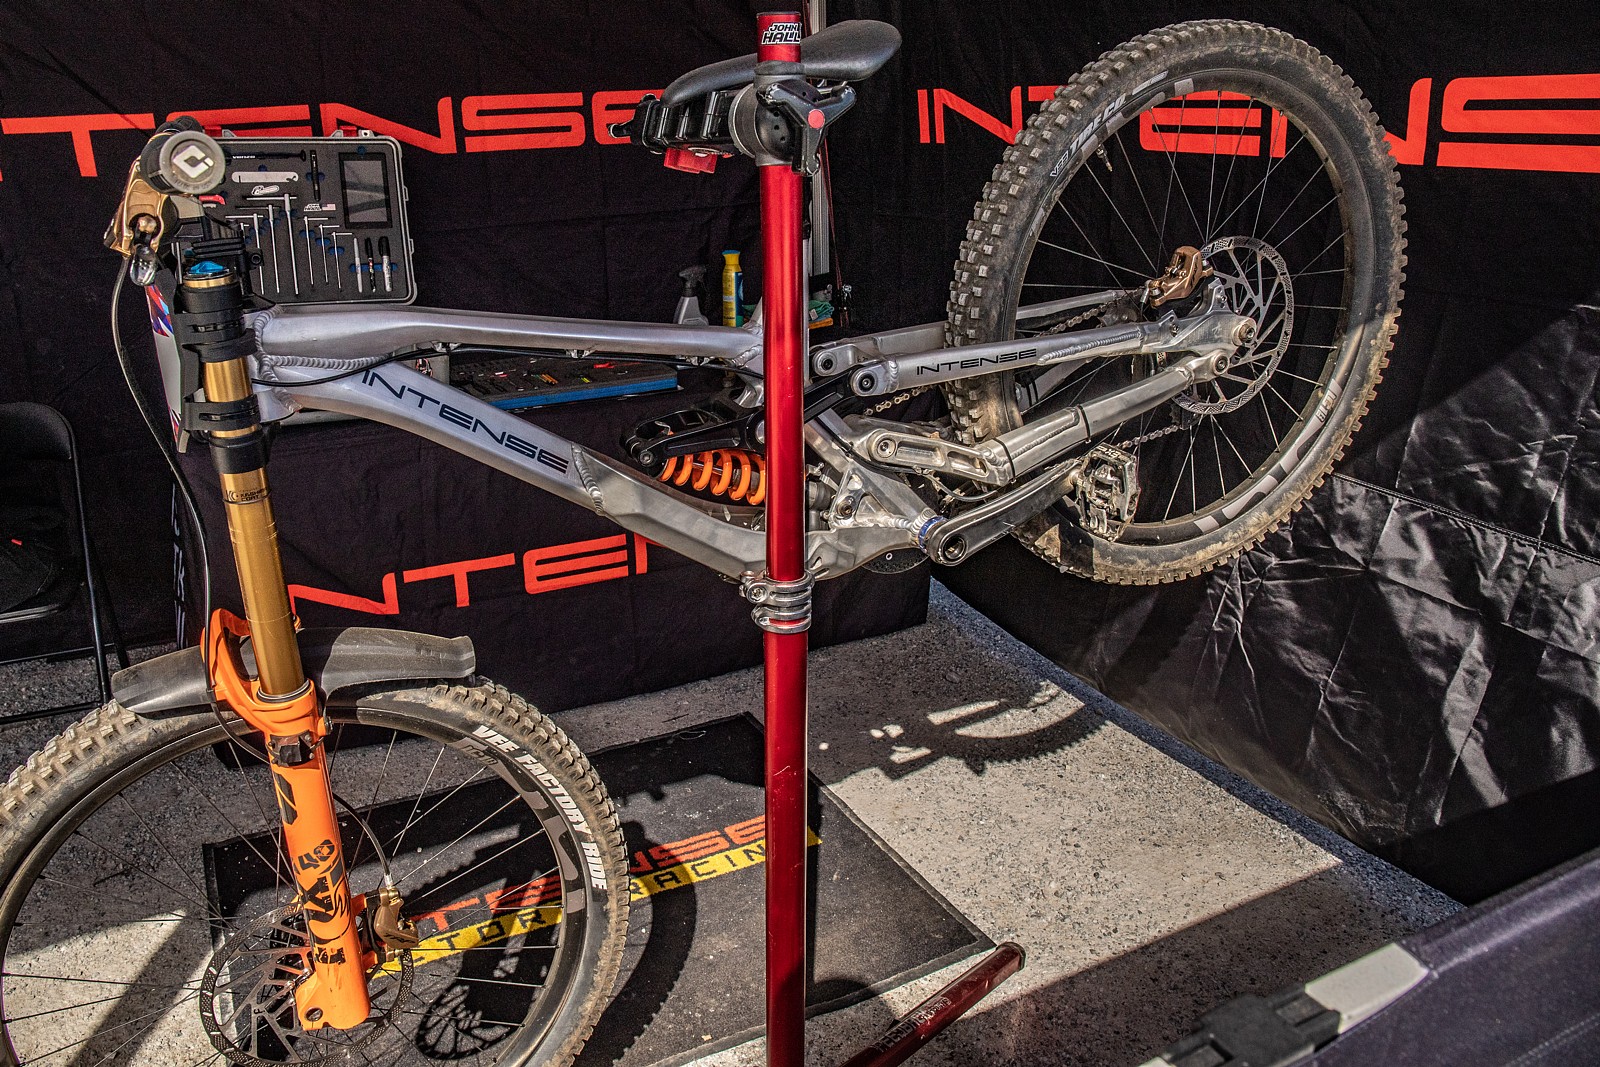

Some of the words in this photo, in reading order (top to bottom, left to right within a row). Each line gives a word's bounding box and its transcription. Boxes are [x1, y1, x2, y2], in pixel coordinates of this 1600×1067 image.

[762, 31, 801, 44] HALL
[769, 23, 800, 32] JOHN
[917, 348, 1037, 376] INTENSE
[361, 369, 569, 474] INTENSE
[472, 725, 520, 753] VEE
[514, 753, 593, 836] FACTORY
[581, 842, 608, 890] RIDE
